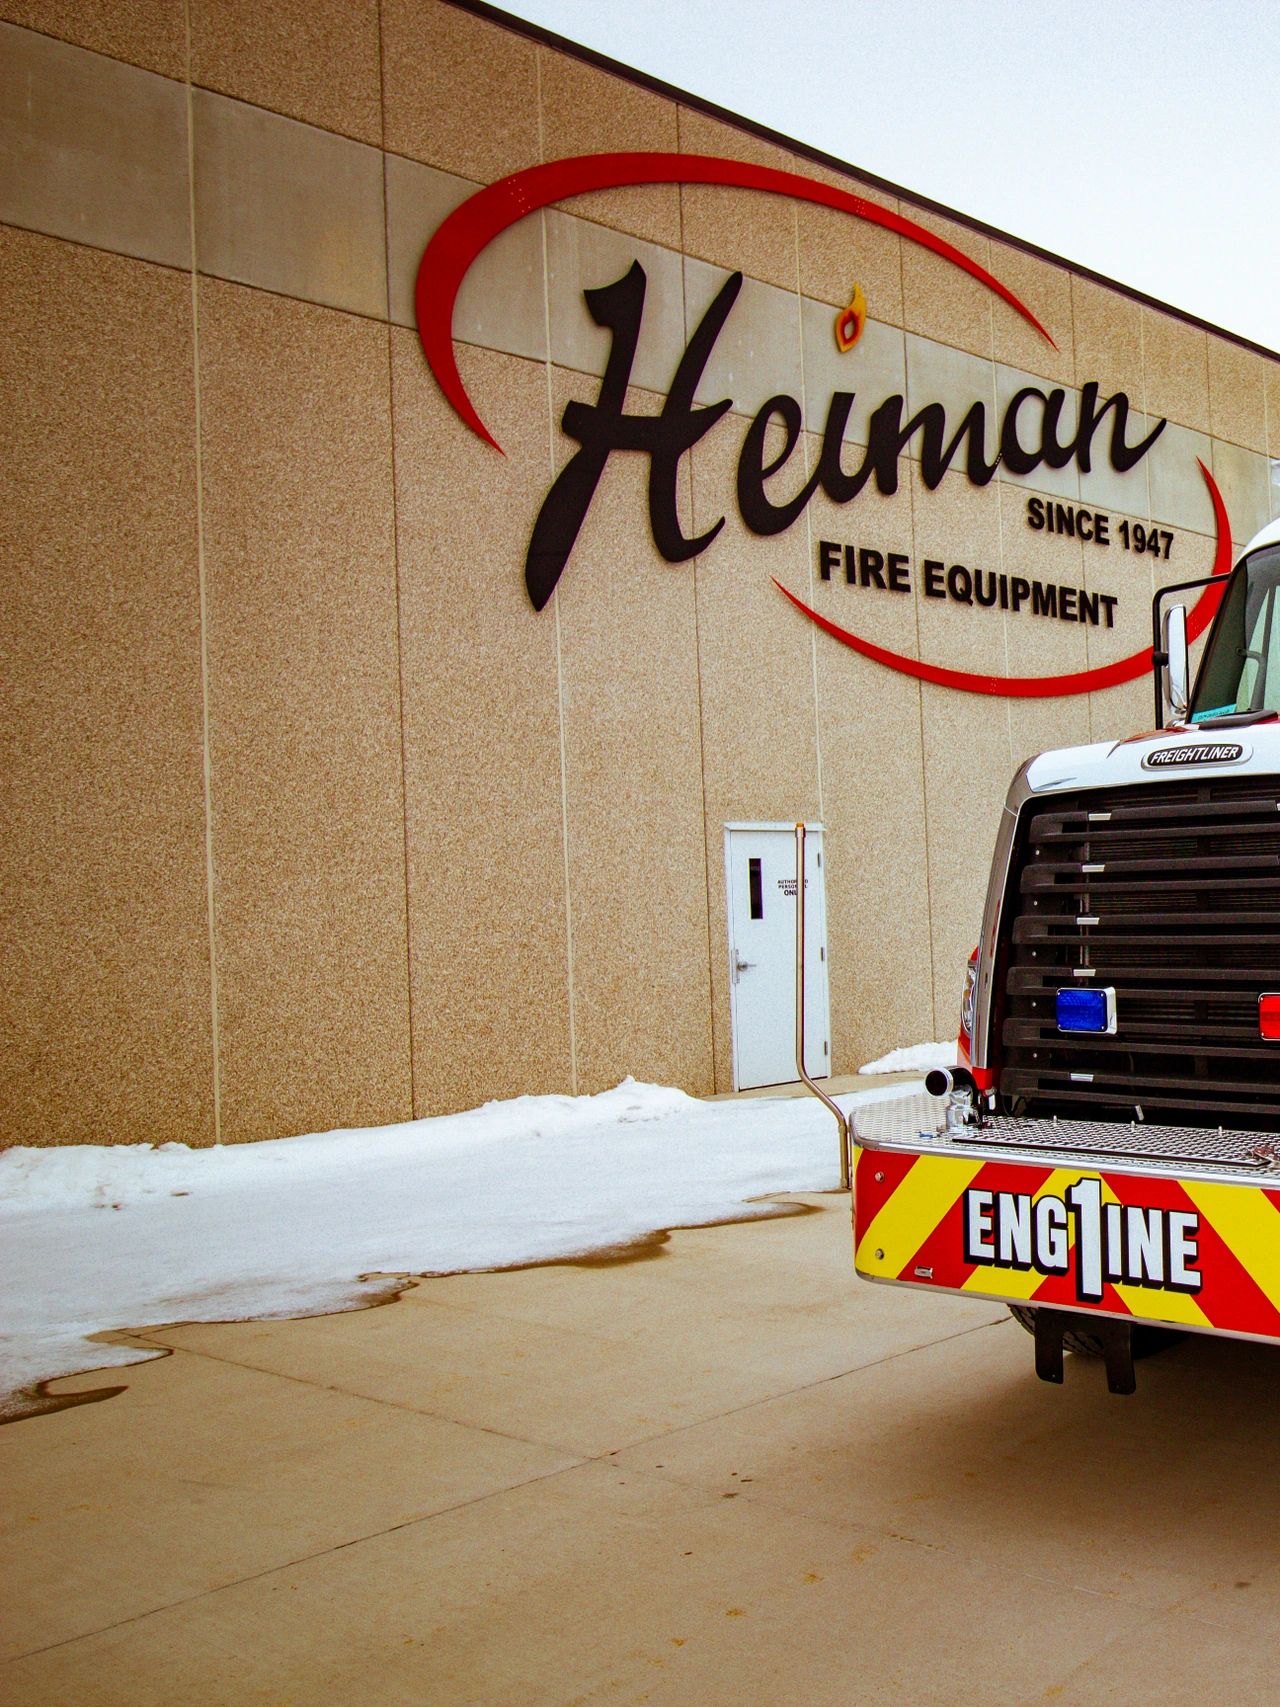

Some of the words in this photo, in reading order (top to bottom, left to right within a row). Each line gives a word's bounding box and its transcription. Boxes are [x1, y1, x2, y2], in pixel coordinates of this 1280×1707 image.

[525, 259, 1168, 612] Heiman
[1027, 499, 1109, 545] SINCE
[1119, 519, 1174, 560] 1947
[819, 541, 910, 595] FIRE
[923, 561, 1118, 629] EQUIPMENT
[1150, 746, 1239, 765] FREIGHTLINER
